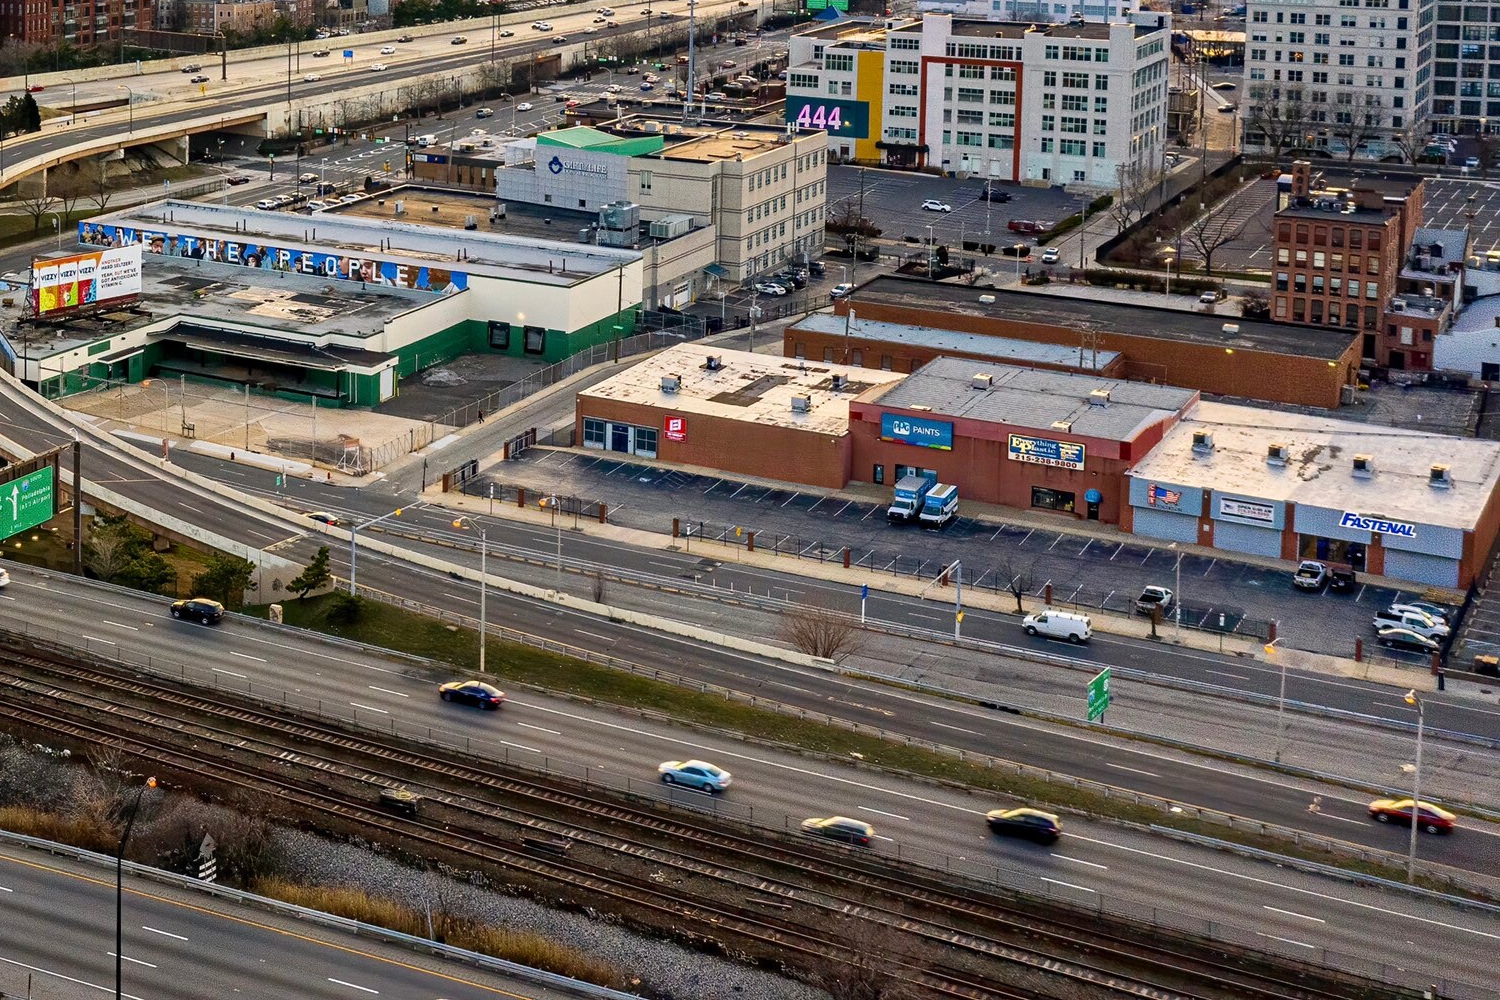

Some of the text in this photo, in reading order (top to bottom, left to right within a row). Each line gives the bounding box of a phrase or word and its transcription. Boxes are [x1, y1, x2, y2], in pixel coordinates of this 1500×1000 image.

[797, 104, 842, 130] 444
[101, 257, 121, 265] ANOTHER
[118, 228, 409, 286] WE THE PEOPLE
[79, 266, 96, 274] VIZZY
[113, 260, 133, 268] SELTZER?
[40, 273, 58, 281] VIZZY
[60, 269, 77, 278] VIZZY
[110, 272, 139, 282] ANTIOXIDANT
[101, 281, 118, 289] VITAMIN
[912, 425, 941, 437] PAINTS
[1020, 442, 1057, 454] Plastic
[1015, 453, 1077, 469] 215-238-9800
[21, 485, 51, 501] Philadelphia
[32, 493, 51, 506] Airport
[1340, 512, 1415, 537] FASTENAL
